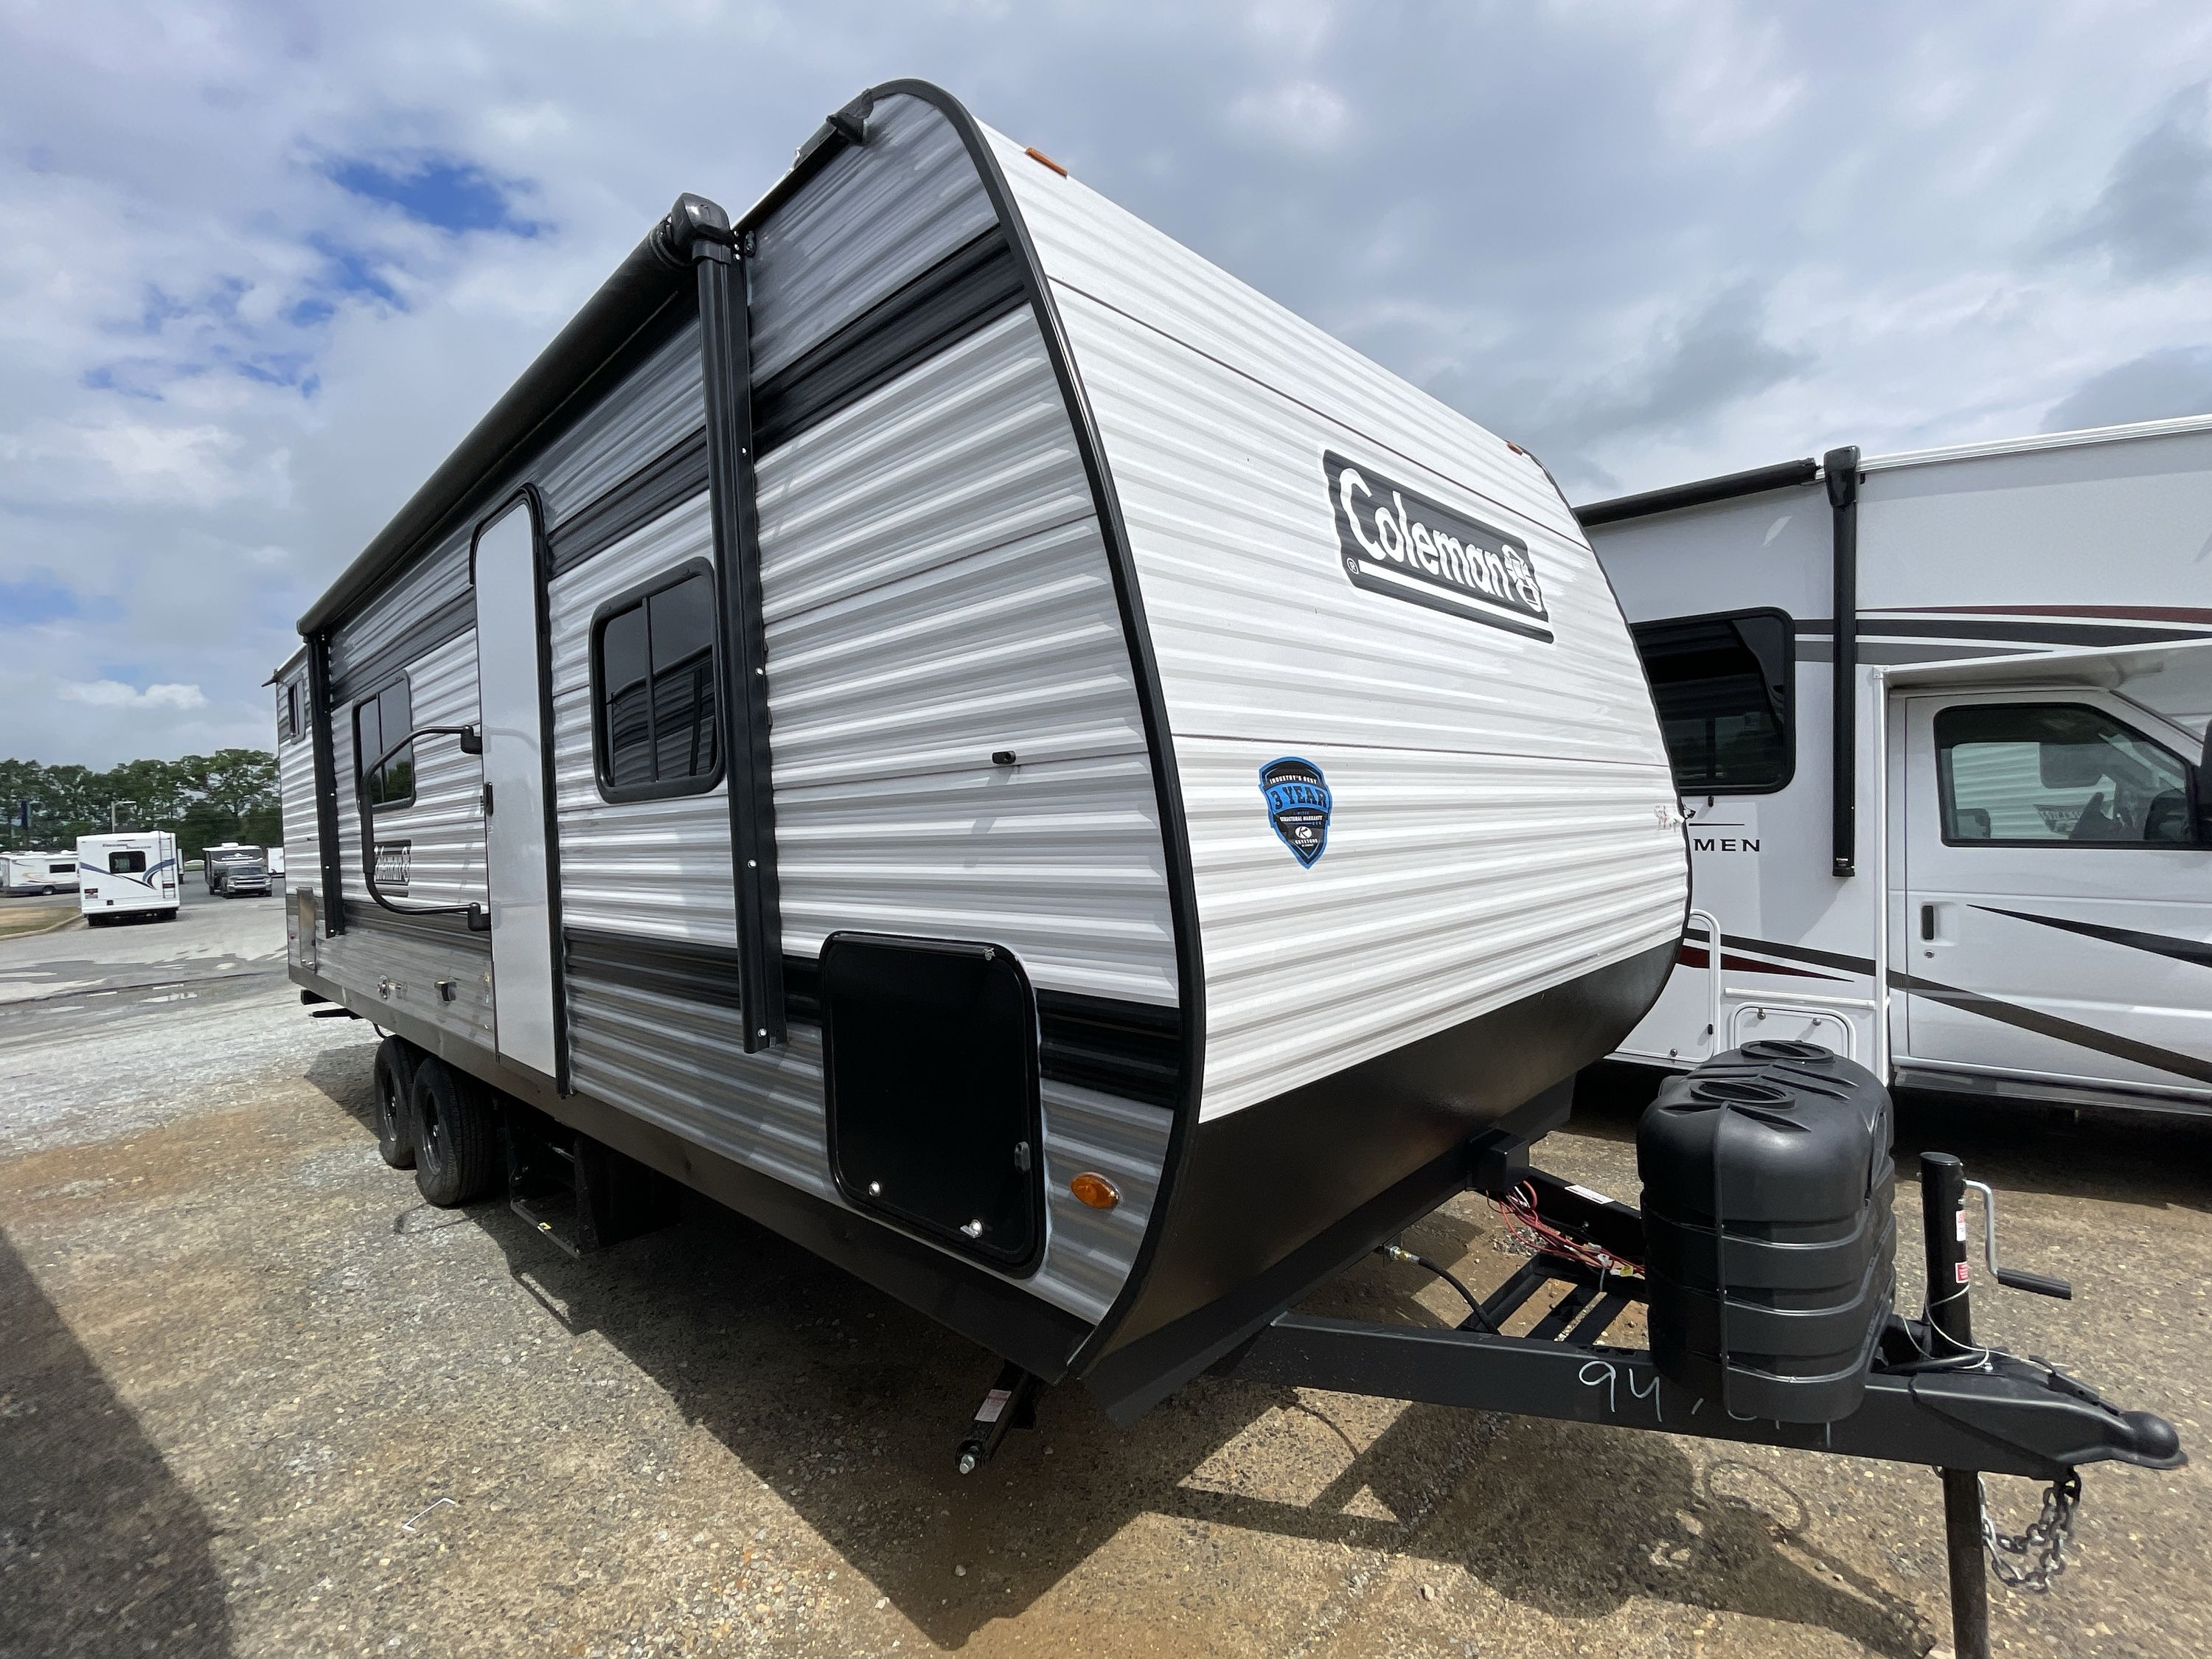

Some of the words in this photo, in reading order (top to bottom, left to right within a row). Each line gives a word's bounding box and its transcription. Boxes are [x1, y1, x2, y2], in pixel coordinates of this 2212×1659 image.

[1339, 467, 1514, 601] Coleman
[1270, 790, 1283, 809] 3
[1283, 785, 1327, 808] YEAR
